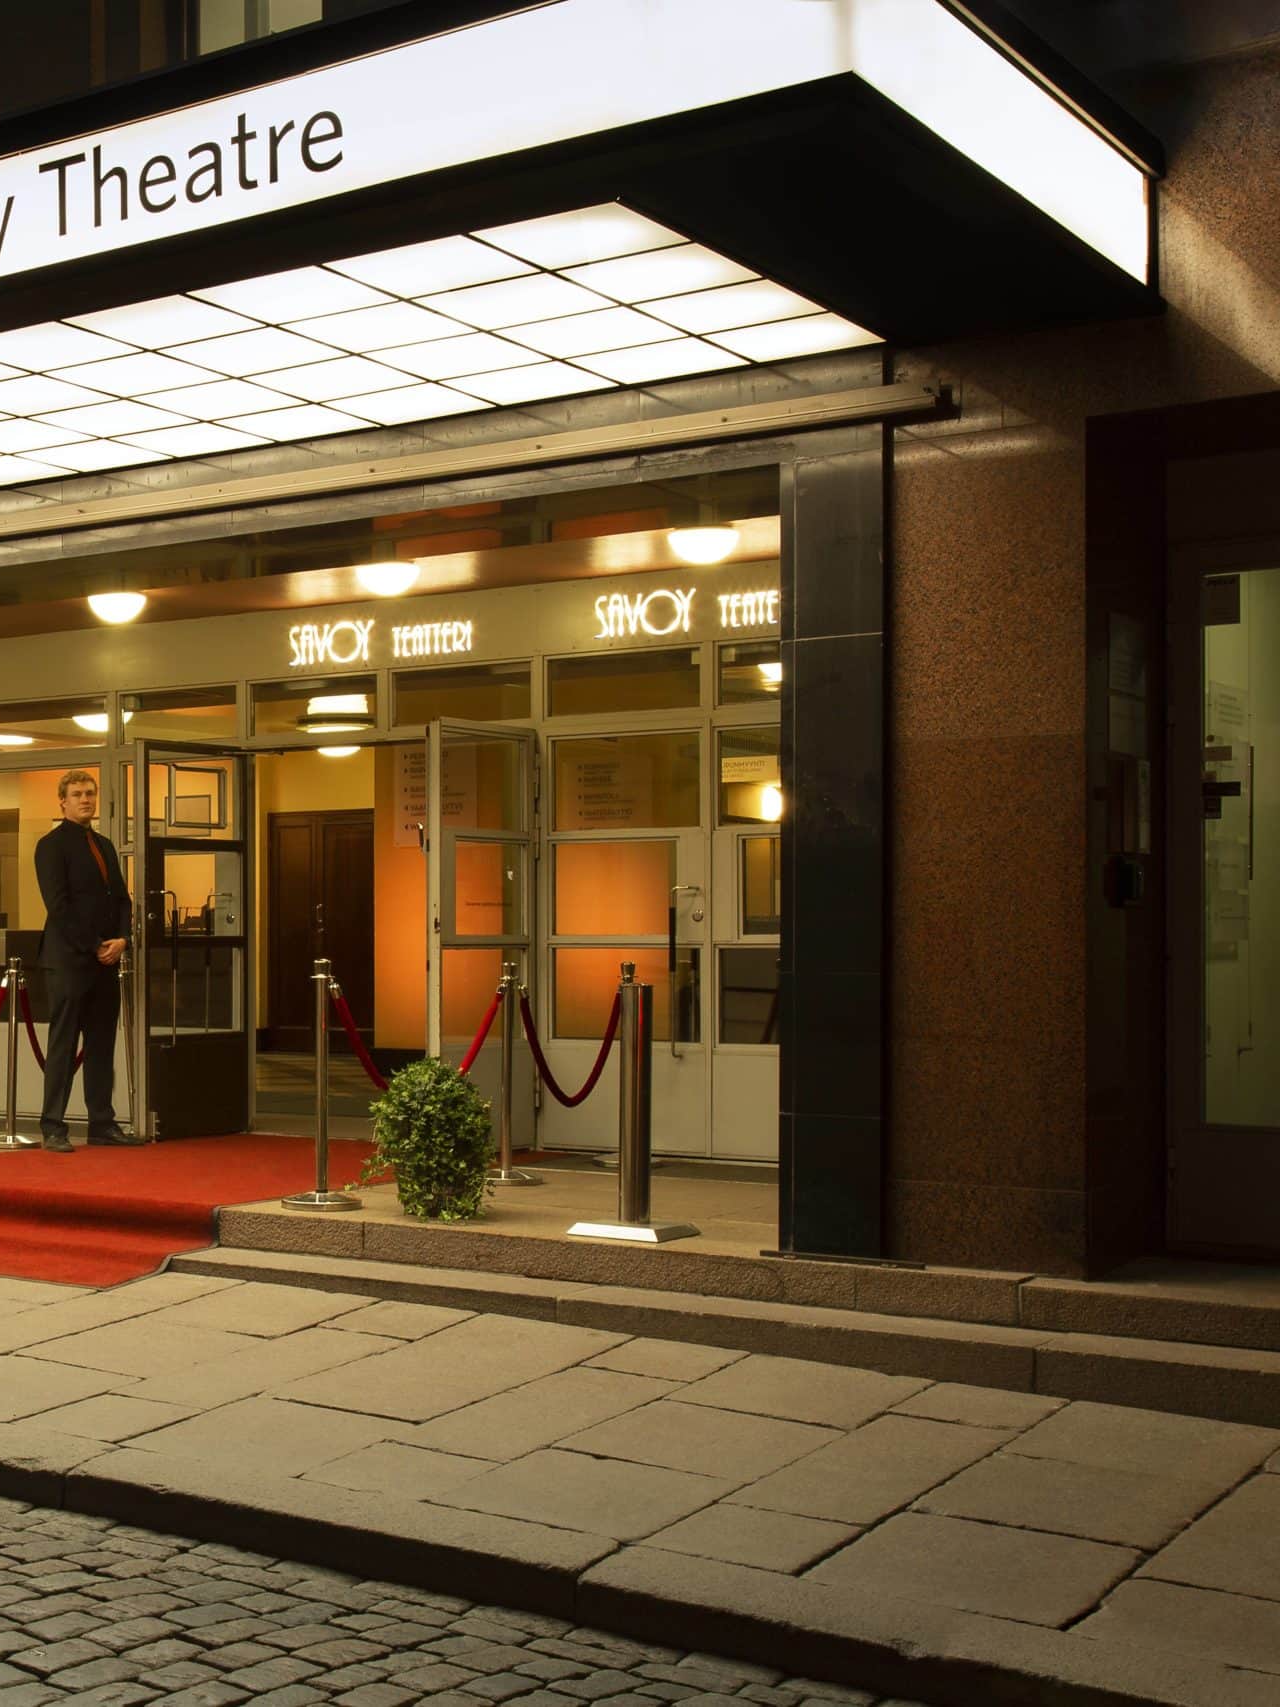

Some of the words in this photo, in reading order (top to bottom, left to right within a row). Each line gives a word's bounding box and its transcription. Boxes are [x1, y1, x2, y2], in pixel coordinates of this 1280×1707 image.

[38, 110, 343, 236] Theatre
[593, 587, 697, 639] SAVOY
[288, 618, 376, 666] SAVOY
[391, 619, 473, 658] TEATTERI
